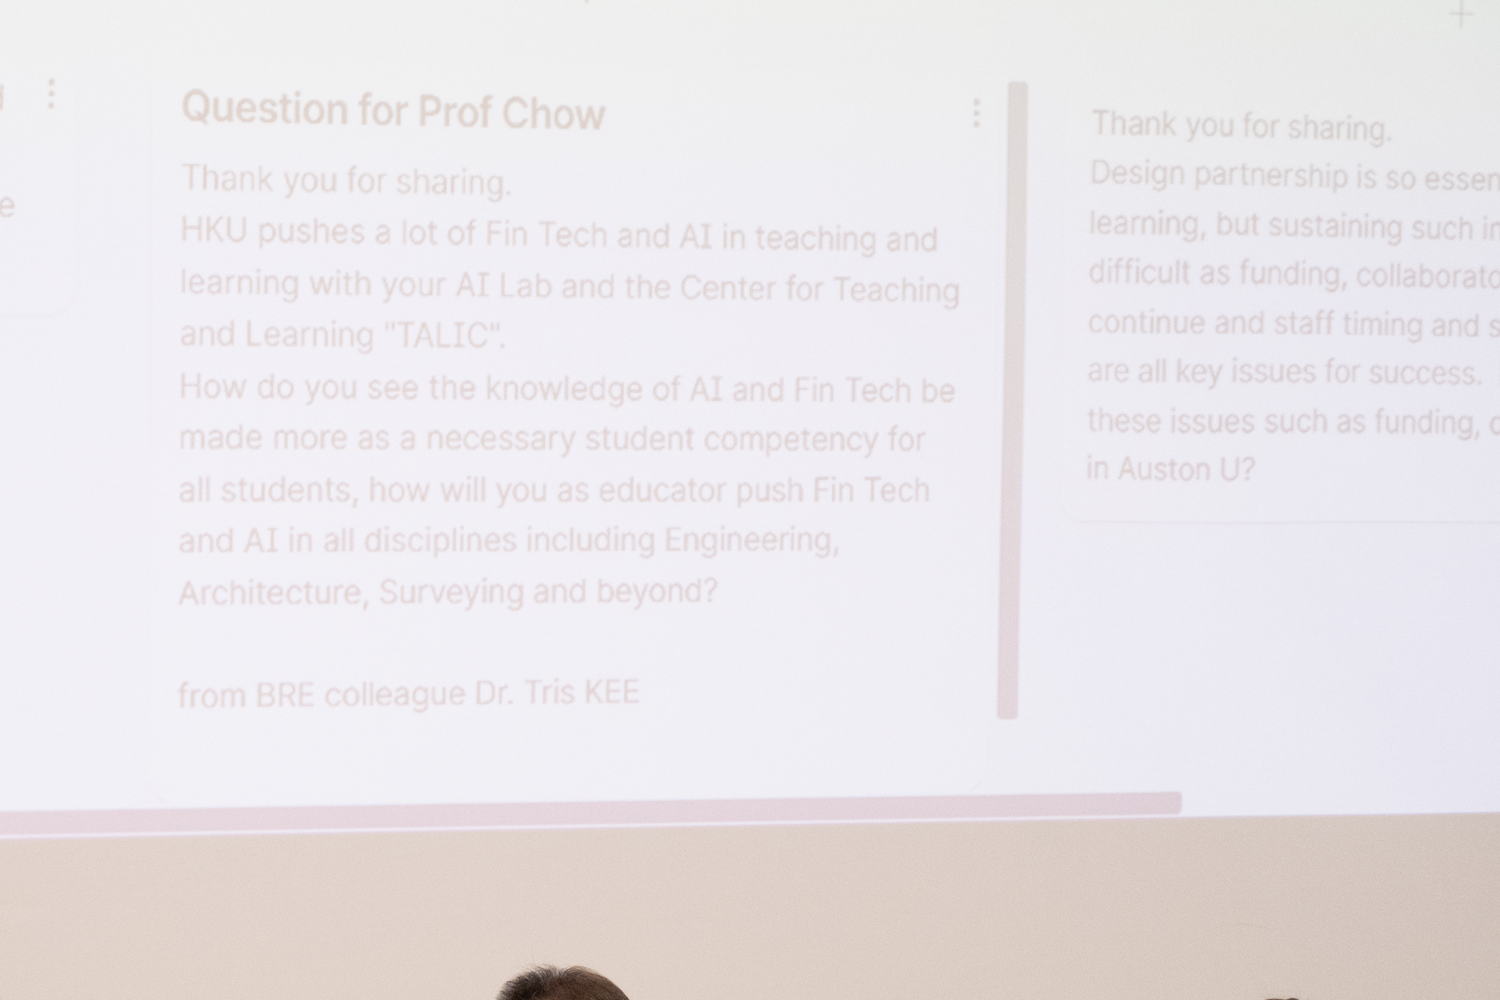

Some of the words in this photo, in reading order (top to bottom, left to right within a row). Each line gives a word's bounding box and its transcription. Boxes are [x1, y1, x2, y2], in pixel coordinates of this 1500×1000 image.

[183, 89, 347, 124] Question
[359, 93, 407, 125] for
[421, 95, 492, 127] Prof
[504, 97, 605, 129] Chow
[183, 164, 272, 191] Thank
[285, 173, 336, 198] you
[348, 166, 386, 193] for
[398, 169, 510, 202] sharing.
[183, 217, 246, 242] HKU
[260, 219, 364, 247] pushes
[376, 225, 390, 244] a
[403, 221, 436, 245] lot
[448, 219, 475, 245] of
[488, 221, 527, 245] Fin
[540, 221, 606, 247] Tech
[618, 224, 669, 248] and
[680, 224, 711, 249] AI
[724, 224, 745, 248] in
[756, 226, 875, 257] teaching
[887, 228, 937, 252] and
[181, 321, 234, 346] and
[247, 321, 373, 354] Learning
[386, 322, 504, 348] "TALIC".
[1088, 455, 1108, 478] in
[1119, 457, 1210, 481] Auston
[1221, 456, 1255, 481] U?
[179, 682, 245, 708] from
[258, 682, 312, 707] BRE
[325, 683, 465, 712] colleague
[476, 681, 512, 704] Dr.
[526, 679, 574, 704] Tris
[586, 679, 638, 703] KEE
